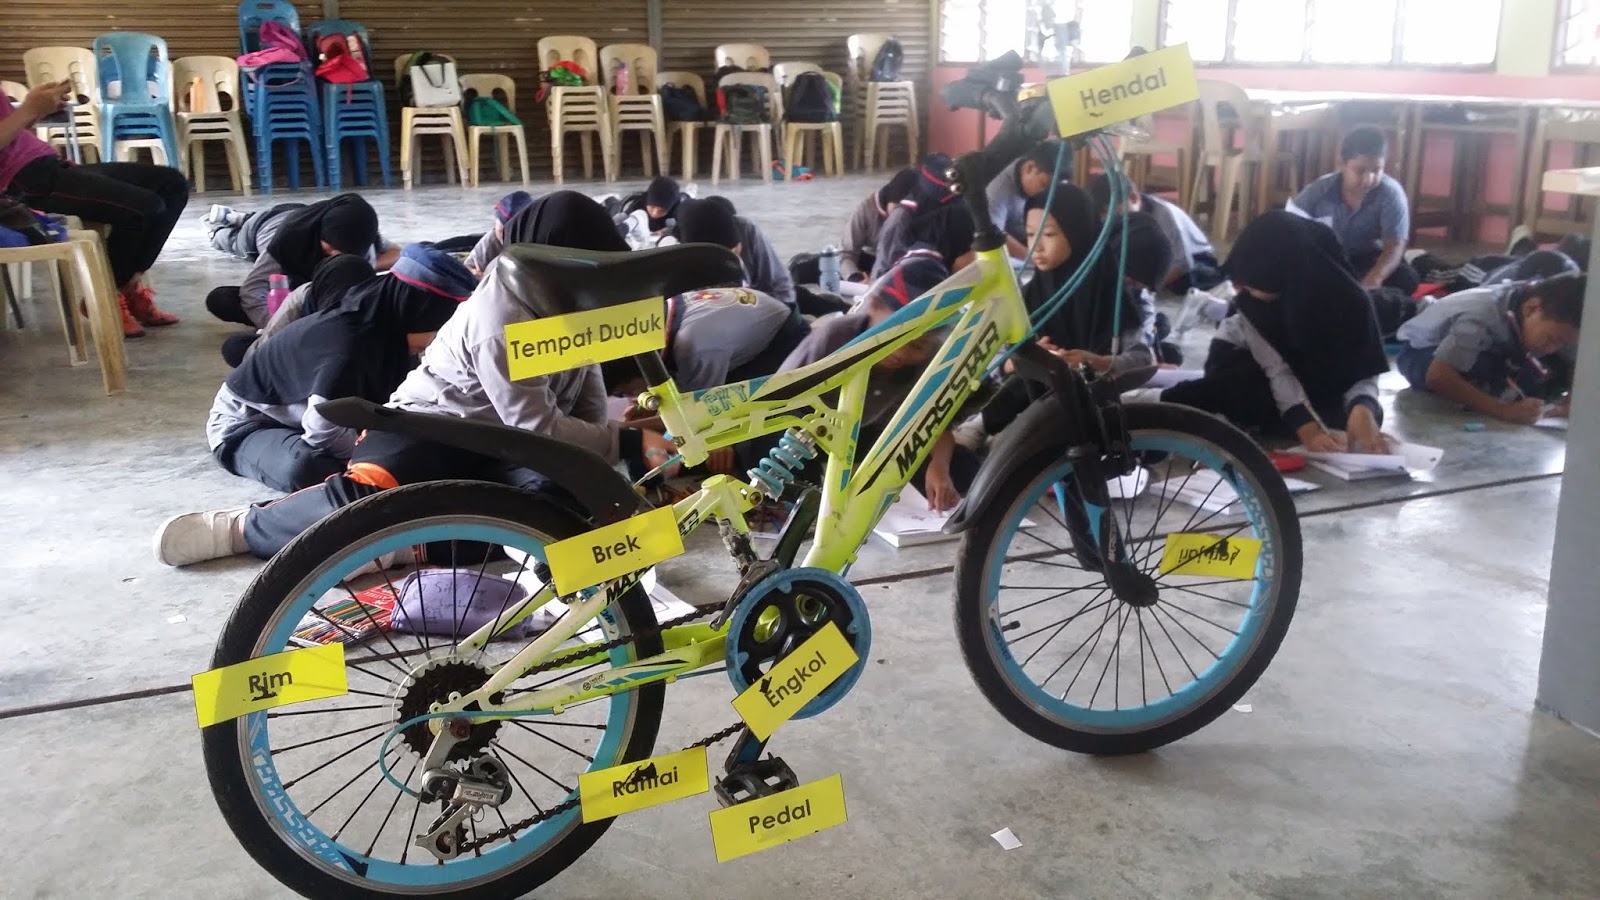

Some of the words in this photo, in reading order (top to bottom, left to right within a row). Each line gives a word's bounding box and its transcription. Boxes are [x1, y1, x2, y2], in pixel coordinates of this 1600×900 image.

[1079, 67, 1168, 109] Hendal
[510, 327, 593, 359] Tempat
[599, 313, 662, 343] Duduk
[591, 534, 642, 564] Brek
[248, 671, 293, 694] Rim
[763, 650, 827, 708] Engkol
[612, 765, 679, 798] Rantai
[748, 799, 812, 834] Pedal
